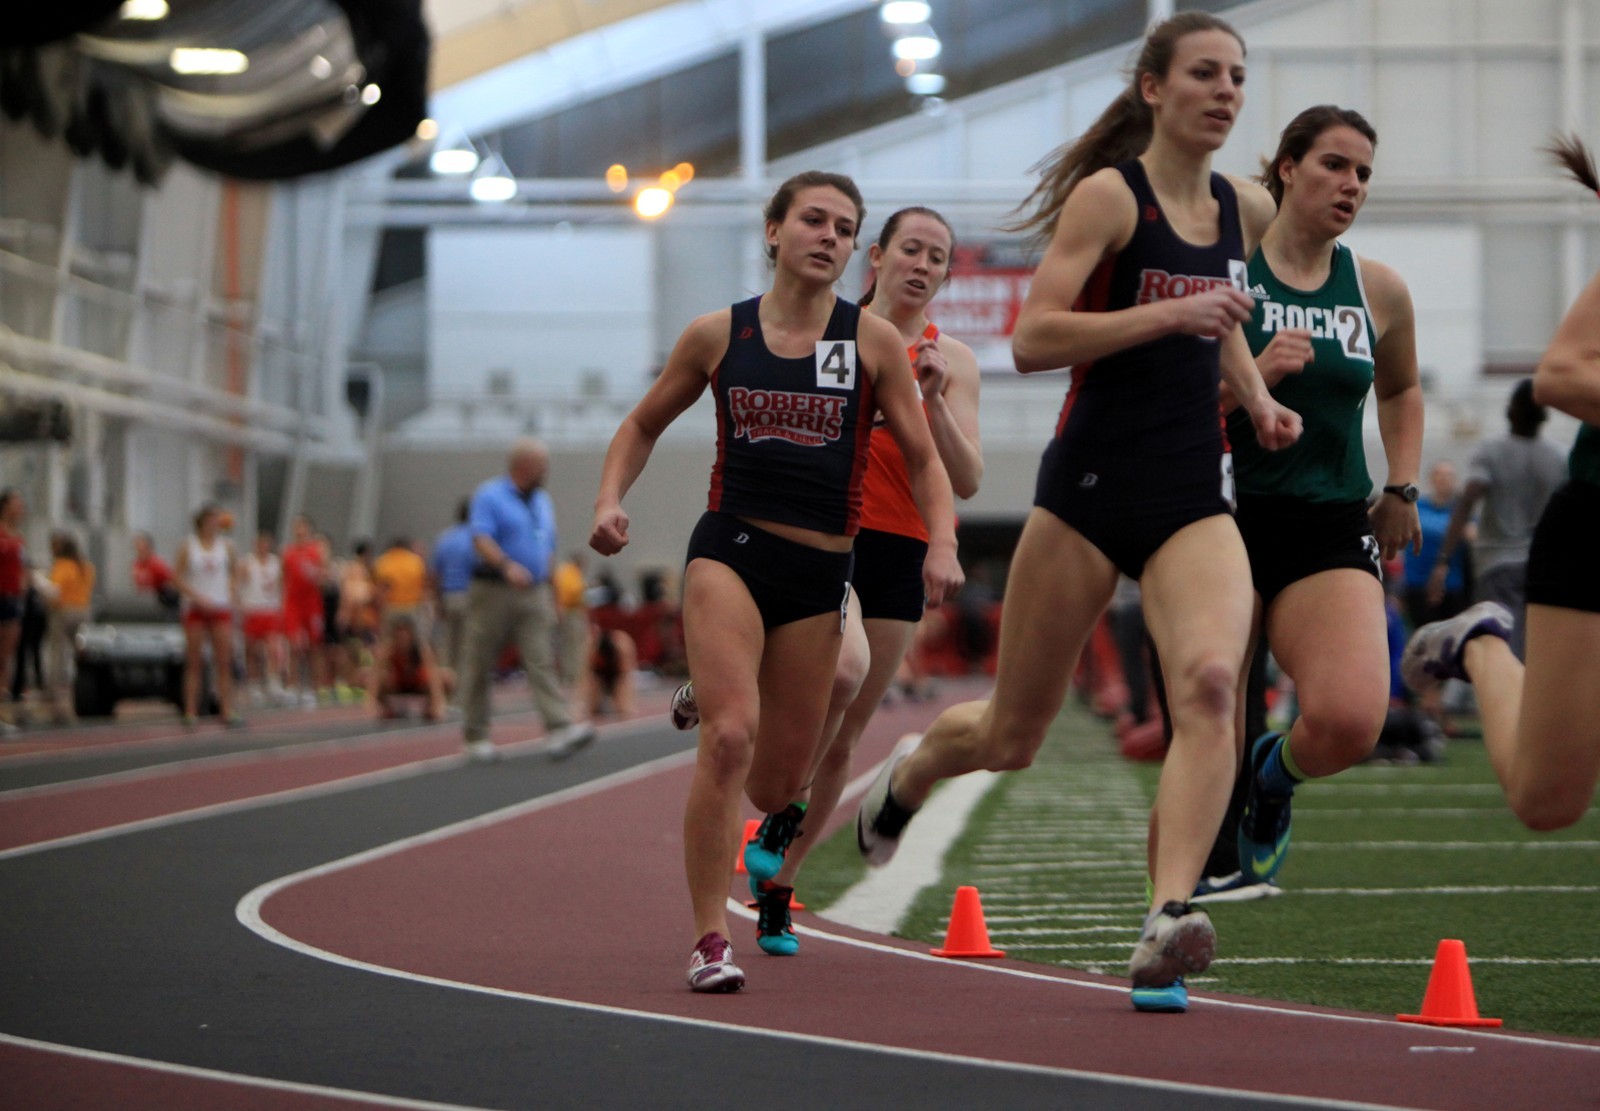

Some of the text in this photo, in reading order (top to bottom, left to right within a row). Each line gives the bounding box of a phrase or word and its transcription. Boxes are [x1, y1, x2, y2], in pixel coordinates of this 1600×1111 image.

[1338, 308, 1368, 356] 2
[820, 343, 850, 384] 4
[729, 387, 847, 416] ROBERT
[733, 411, 843, 440] MORRIS
[751, 428, 782, 439] TRACK
